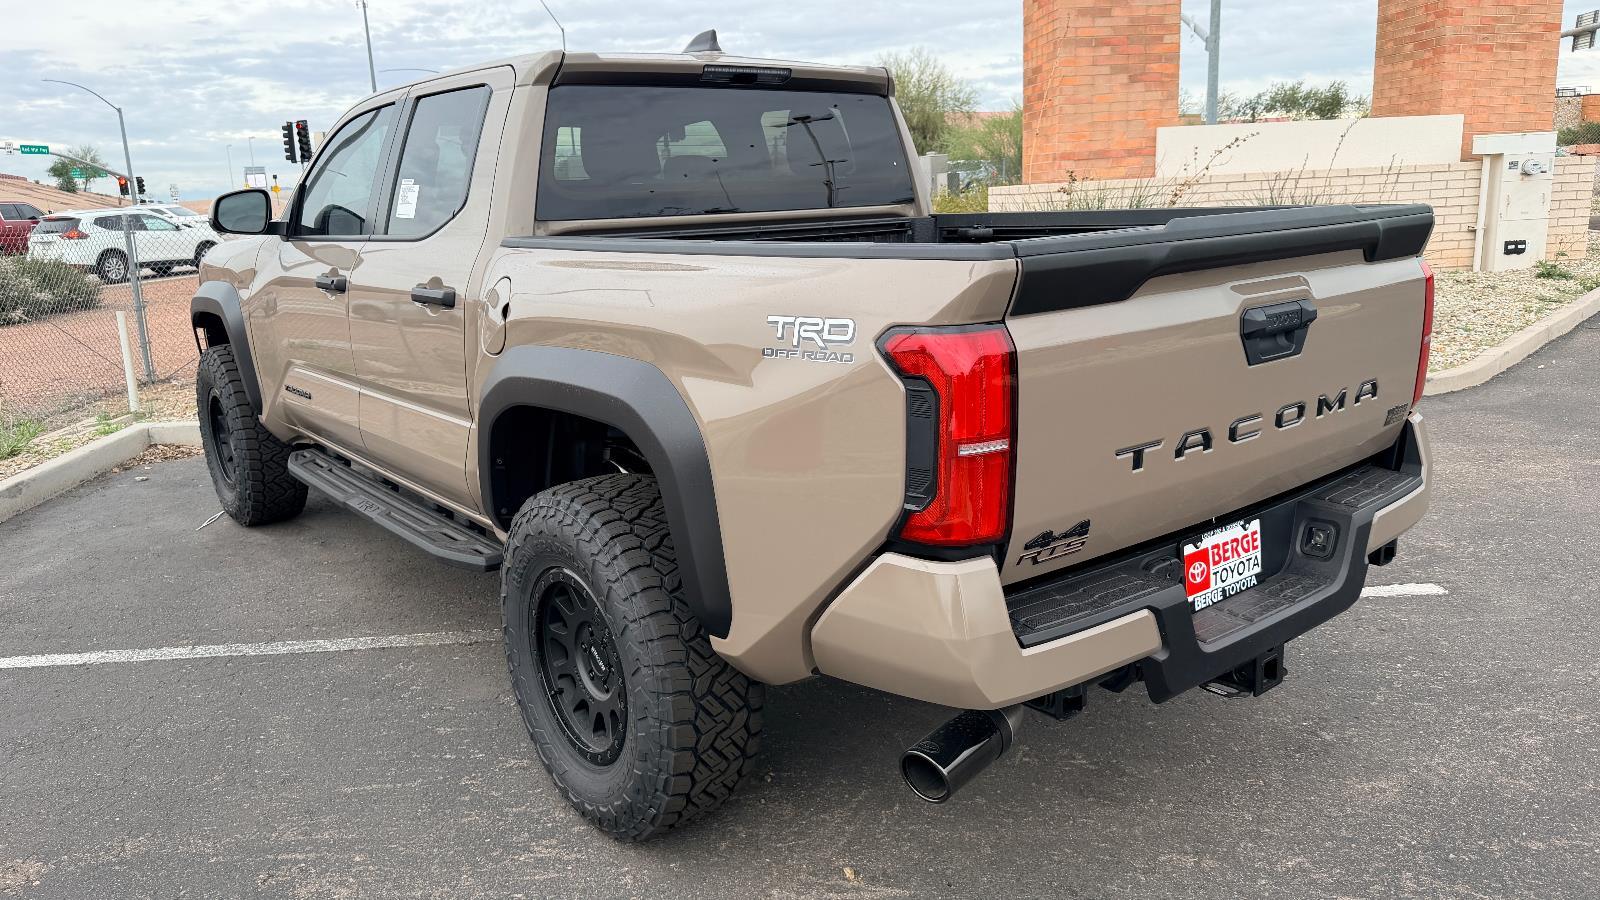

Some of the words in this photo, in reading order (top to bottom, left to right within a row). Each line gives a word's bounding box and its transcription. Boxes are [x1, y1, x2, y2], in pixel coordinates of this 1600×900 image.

[767, 315, 856, 350] TRD
[762, 347, 799, 359] OFF
[801, 351, 854, 363] ROAD
[1114, 377, 1379, 474] TACOMA
[1210, 529, 1260, 567] BERGE
[1212, 554, 1260, 587] TOYOTA
[1194, 587, 1223, 611] BERGE
[1225, 575, 1257, 597] TOYOTA
